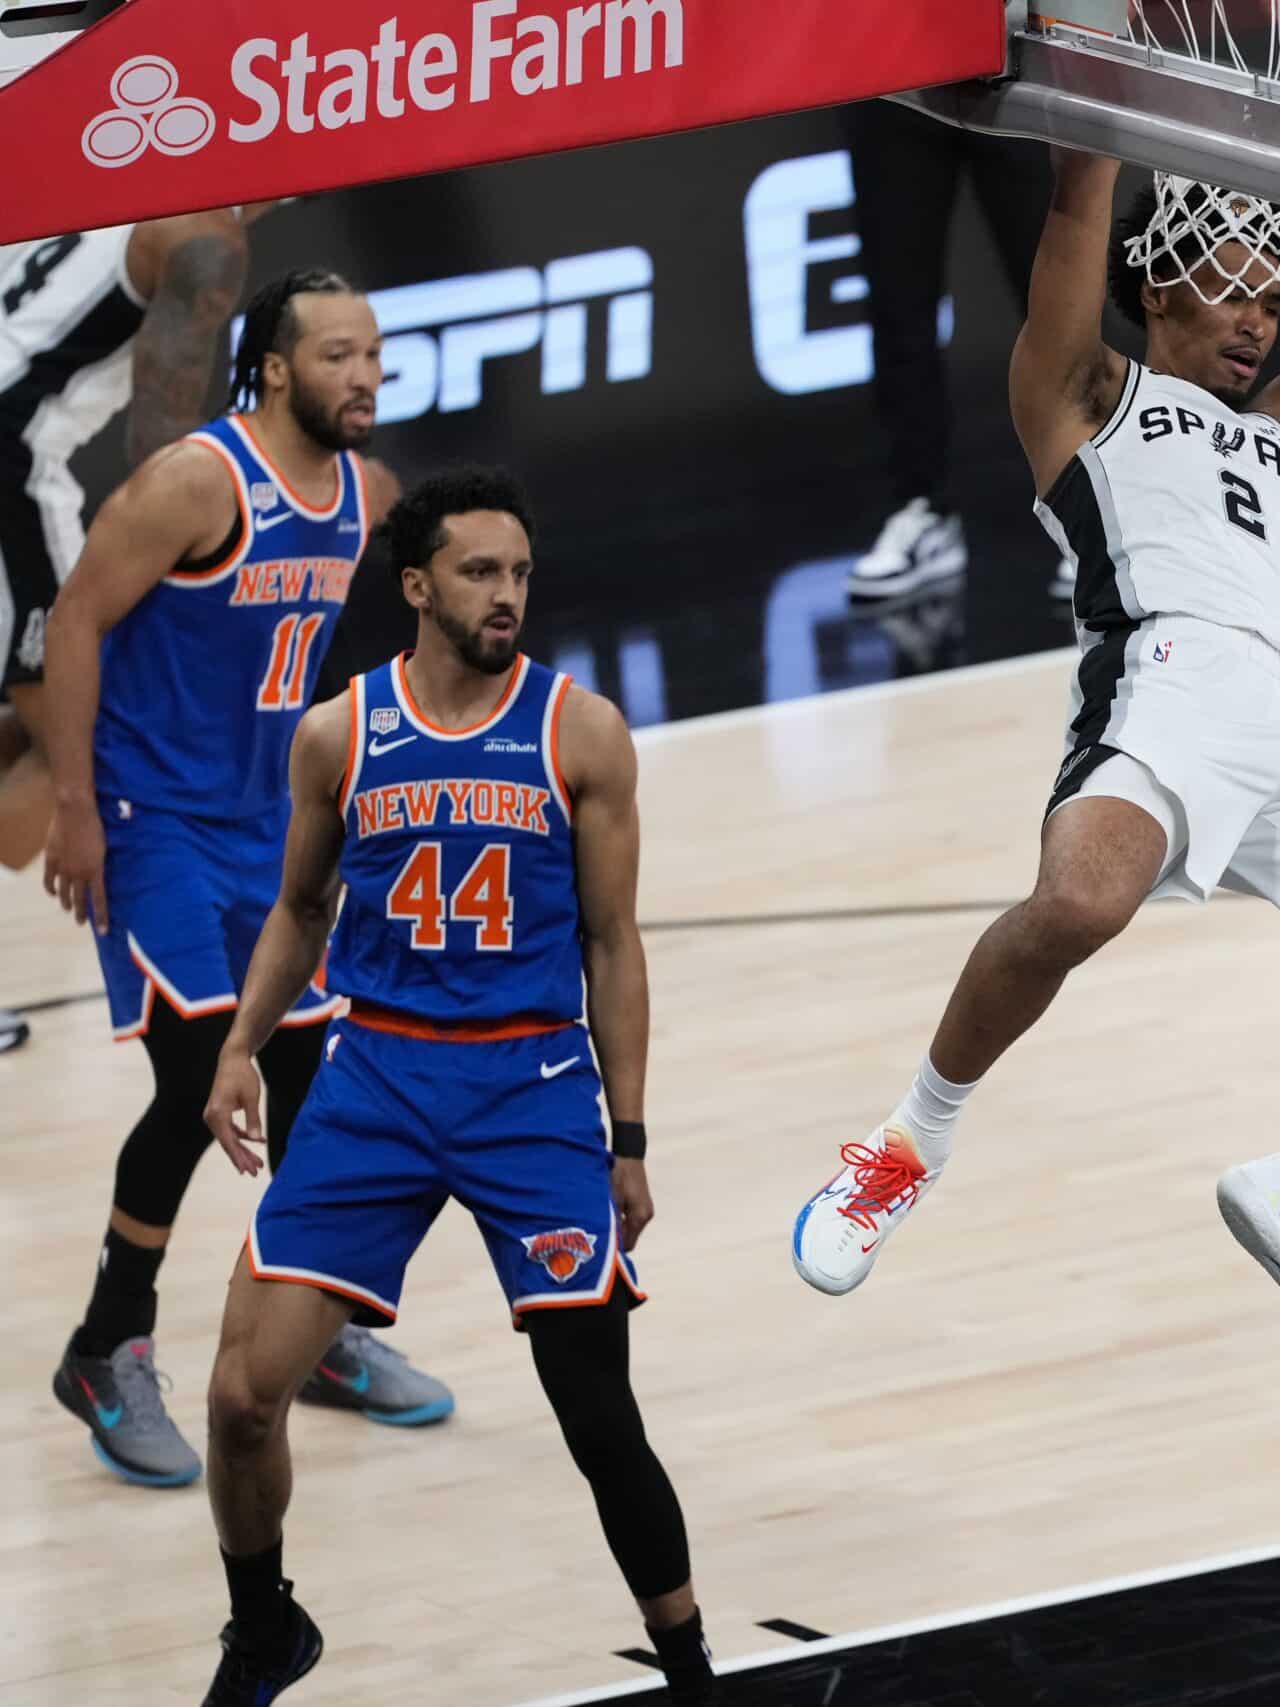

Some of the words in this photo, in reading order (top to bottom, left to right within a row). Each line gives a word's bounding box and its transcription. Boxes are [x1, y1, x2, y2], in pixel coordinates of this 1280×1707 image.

[231, 246, 653, 426] SPN
[1217, 466, 1270, 545] 2
[229, 558, 310, 607] NEW
[256, 612, 327, 712] 11
[355, 780, 442, 840] NEW
[445, 778, 553, 837] YORK
[386, 841, 515, 951] 44
